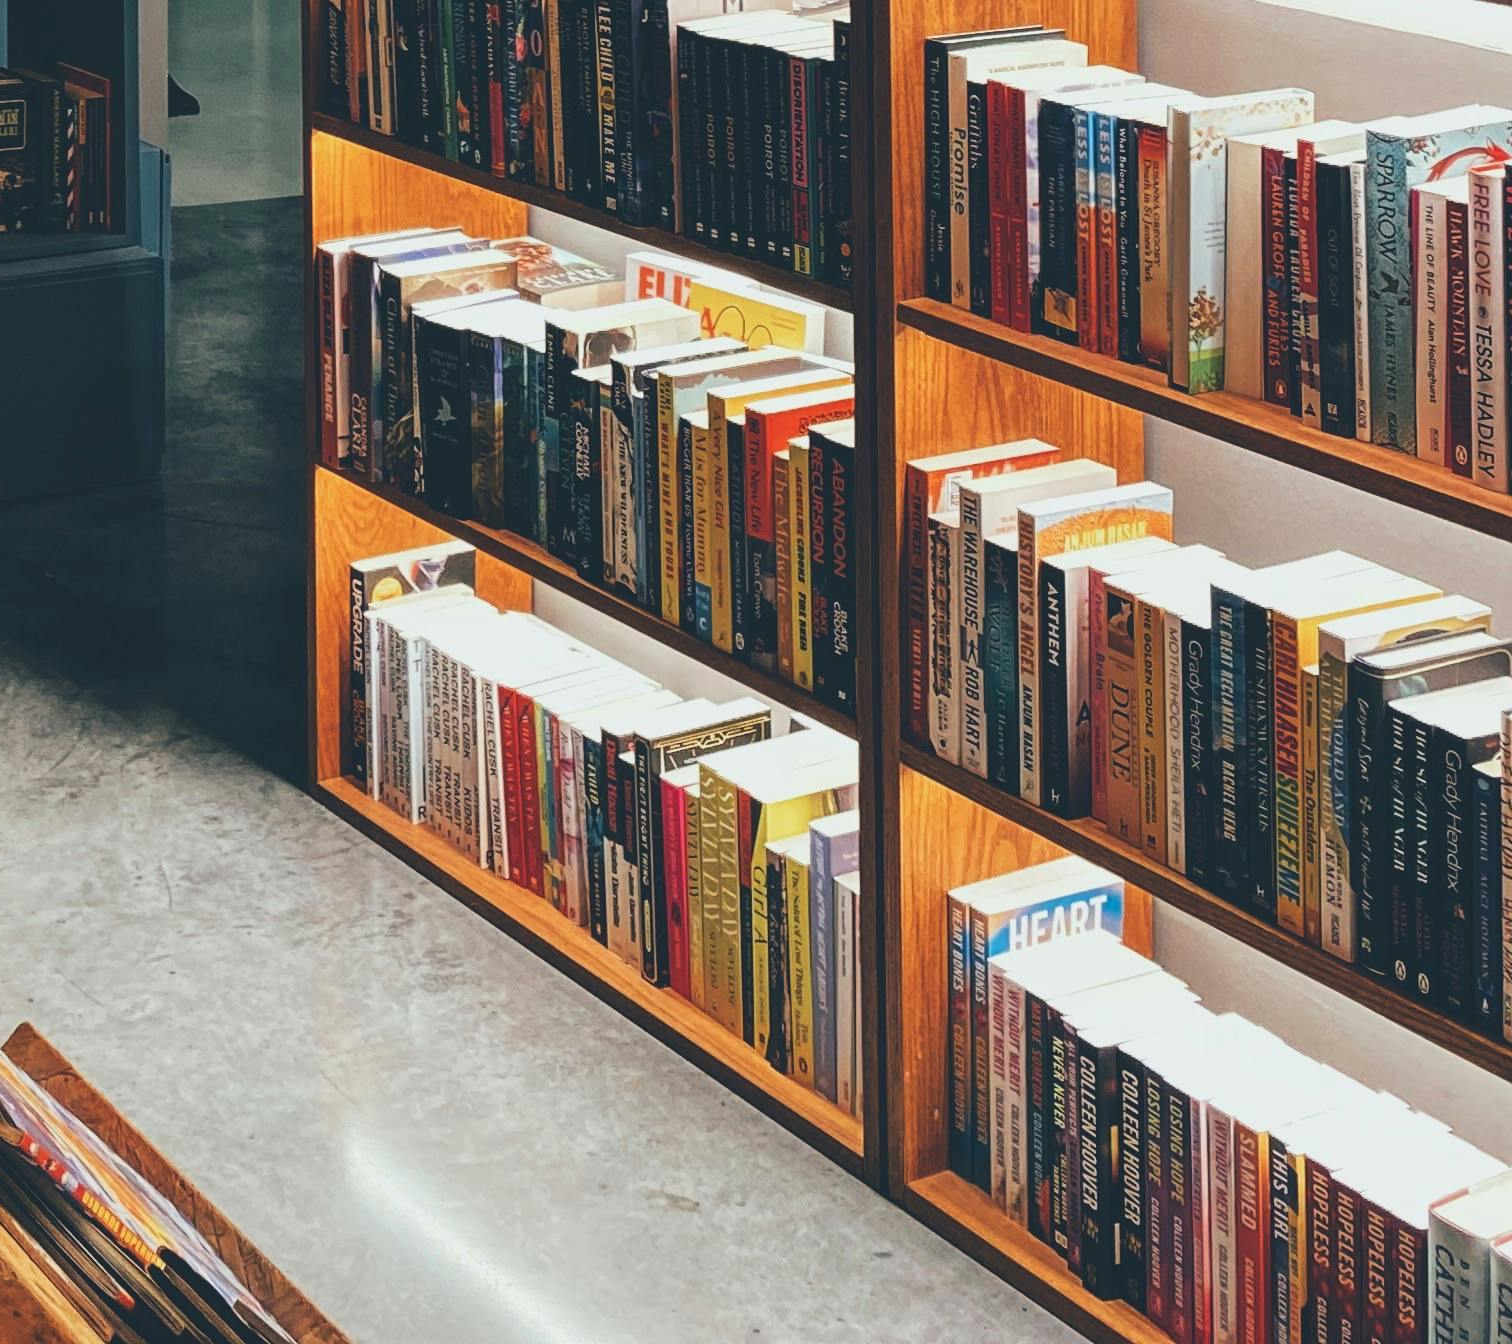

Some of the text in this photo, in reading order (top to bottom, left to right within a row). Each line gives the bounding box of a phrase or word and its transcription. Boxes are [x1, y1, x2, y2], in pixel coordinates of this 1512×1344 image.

[598, 6, 616, 184] LEE CHILD MAKE ME
[793, 65, 805, 182] DISORIENTATION
[954, 127, 967, 216] Promise
[1378, 154, 1398, 262] SPARROW
[1426, 272, 1435, 314] BEAUTY
[1427, 253, 1434, 266] OF
[1450, 211, 1465, 356] HAWK MOUNTAIN
[1427, 344, 1435, 404] Hollinghurst
[1473, 183, 1494, 479] FREE LOVE TESSA HADLEY
[811, 447, 825, 564] RECURSION
[832, 458, 850, 578] ABANDON
[351, 578, 362, 674] UPGRADE
[962, 496, 980, 751] THE WAREHOUSE ROB HART
[1018, 521, 1035, 774] HISTORY'S ANGEL ANJUM HASAN
[1046, 582, 1062, 666] ANTHEM
[1110, 681, 1130, 783] DUNE
[1168, 626, 1179, 740] MOTHERHOOD
[1442, 749, 1461, 894] Grady Hendrix
[952, 907, 965, 993] HEART BONES
[1008, 896, 1108, 953] HEART
[1052, 1036, 1065, 1130] NEVER NEVER
[1081, 1056, 1098, 1211] COLLEEN HOOVER
[1147, 1077, 1161, 1185] LOSING HOPE
[1240, 1133, 1256, 1231] SLAMMED
[1273, 1150, 1288, 1242] THIS GIRL
[1312, 1171, 1329, 1267] HOPELESS
